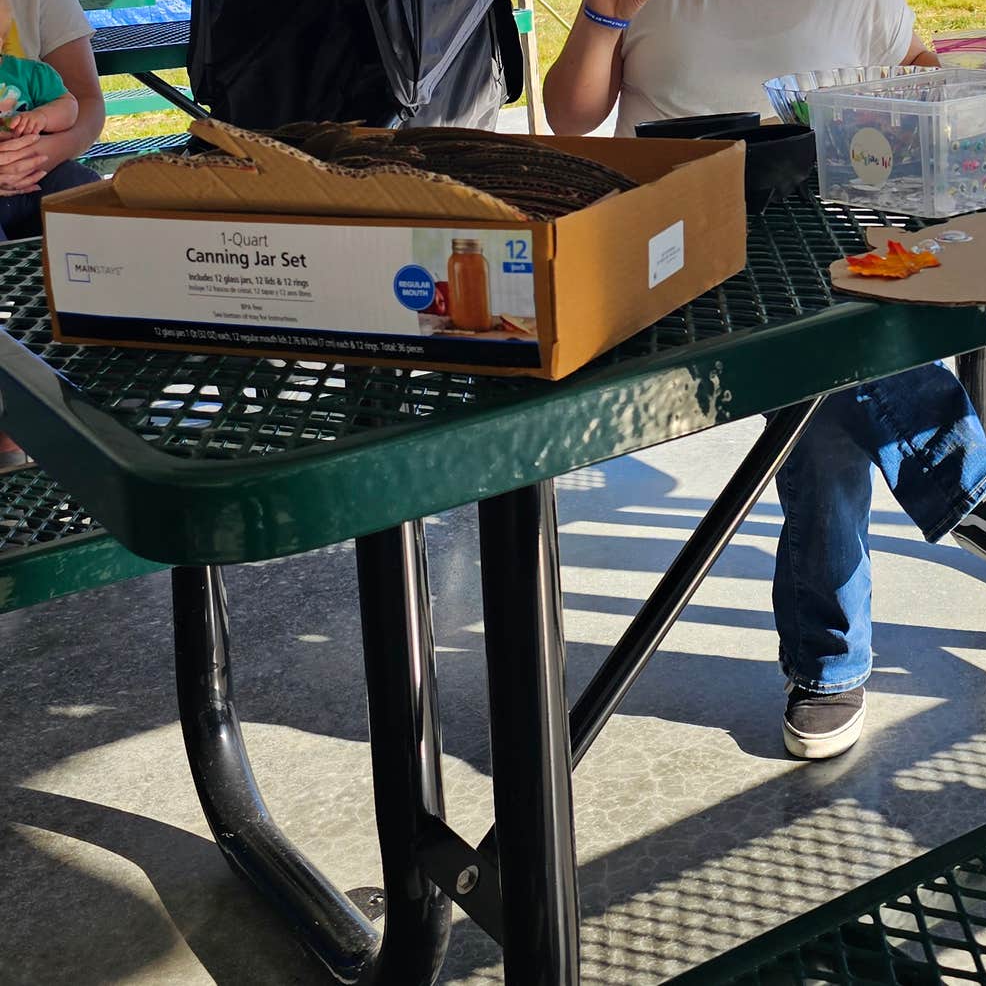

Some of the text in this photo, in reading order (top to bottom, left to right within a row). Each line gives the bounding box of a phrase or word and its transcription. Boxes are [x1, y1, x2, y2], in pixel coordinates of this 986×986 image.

[221, 232, 269, 247] 1-Quart
[505, 239, 528, 259] 12
[186, 248, 307, 269] Canning Jar Set
[188, 273, 309, 288] Includes 12 glass jars, 12 lids & 12 rings
[399, 280, 431, 289] REGULAR
[402, 289, 428, 297] MOUTH
